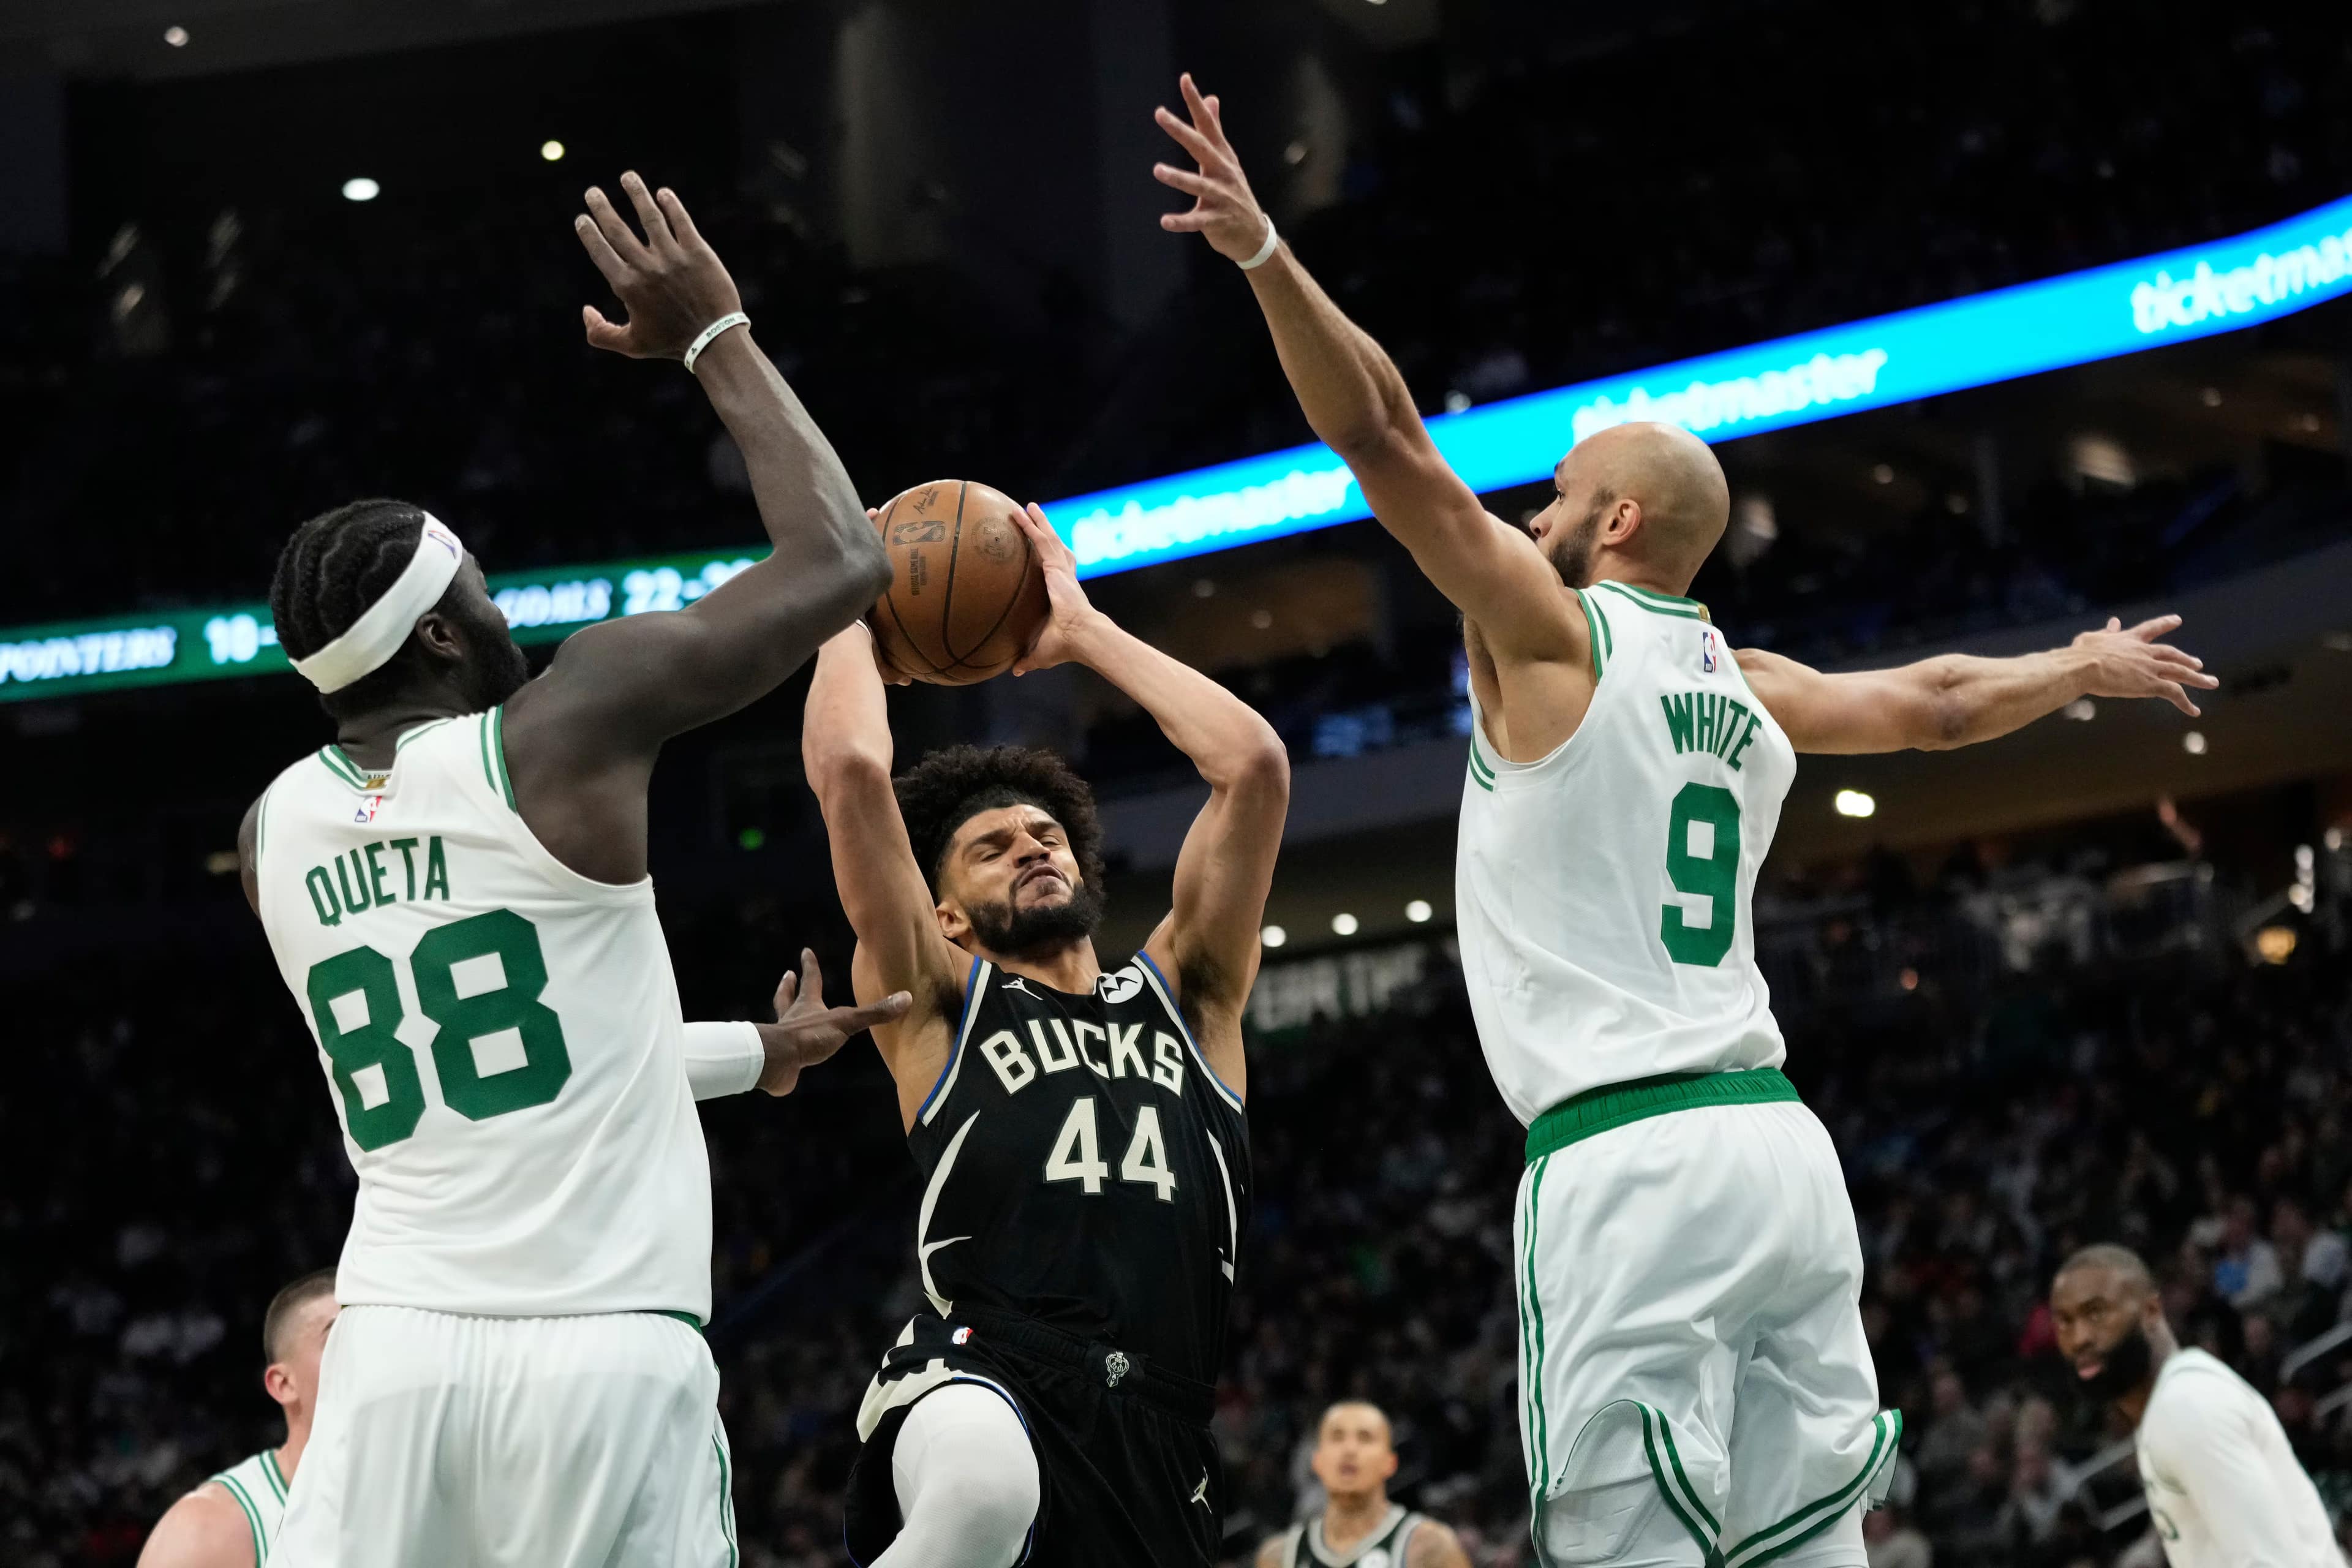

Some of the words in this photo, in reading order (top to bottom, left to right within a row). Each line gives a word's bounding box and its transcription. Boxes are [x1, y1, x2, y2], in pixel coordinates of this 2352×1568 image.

[706, 318, 735, 338] BOSTON
[1660, 692, 1762, 772] WHITE
[306, 836, 450, 927] QUETA
[1660, 782, 1741, 967] 9
[307, 908, 572, 1153] 88
[979, 1018, 1185, 1098] BUCKS
[1043, 1095, 1178, 1204] 44
